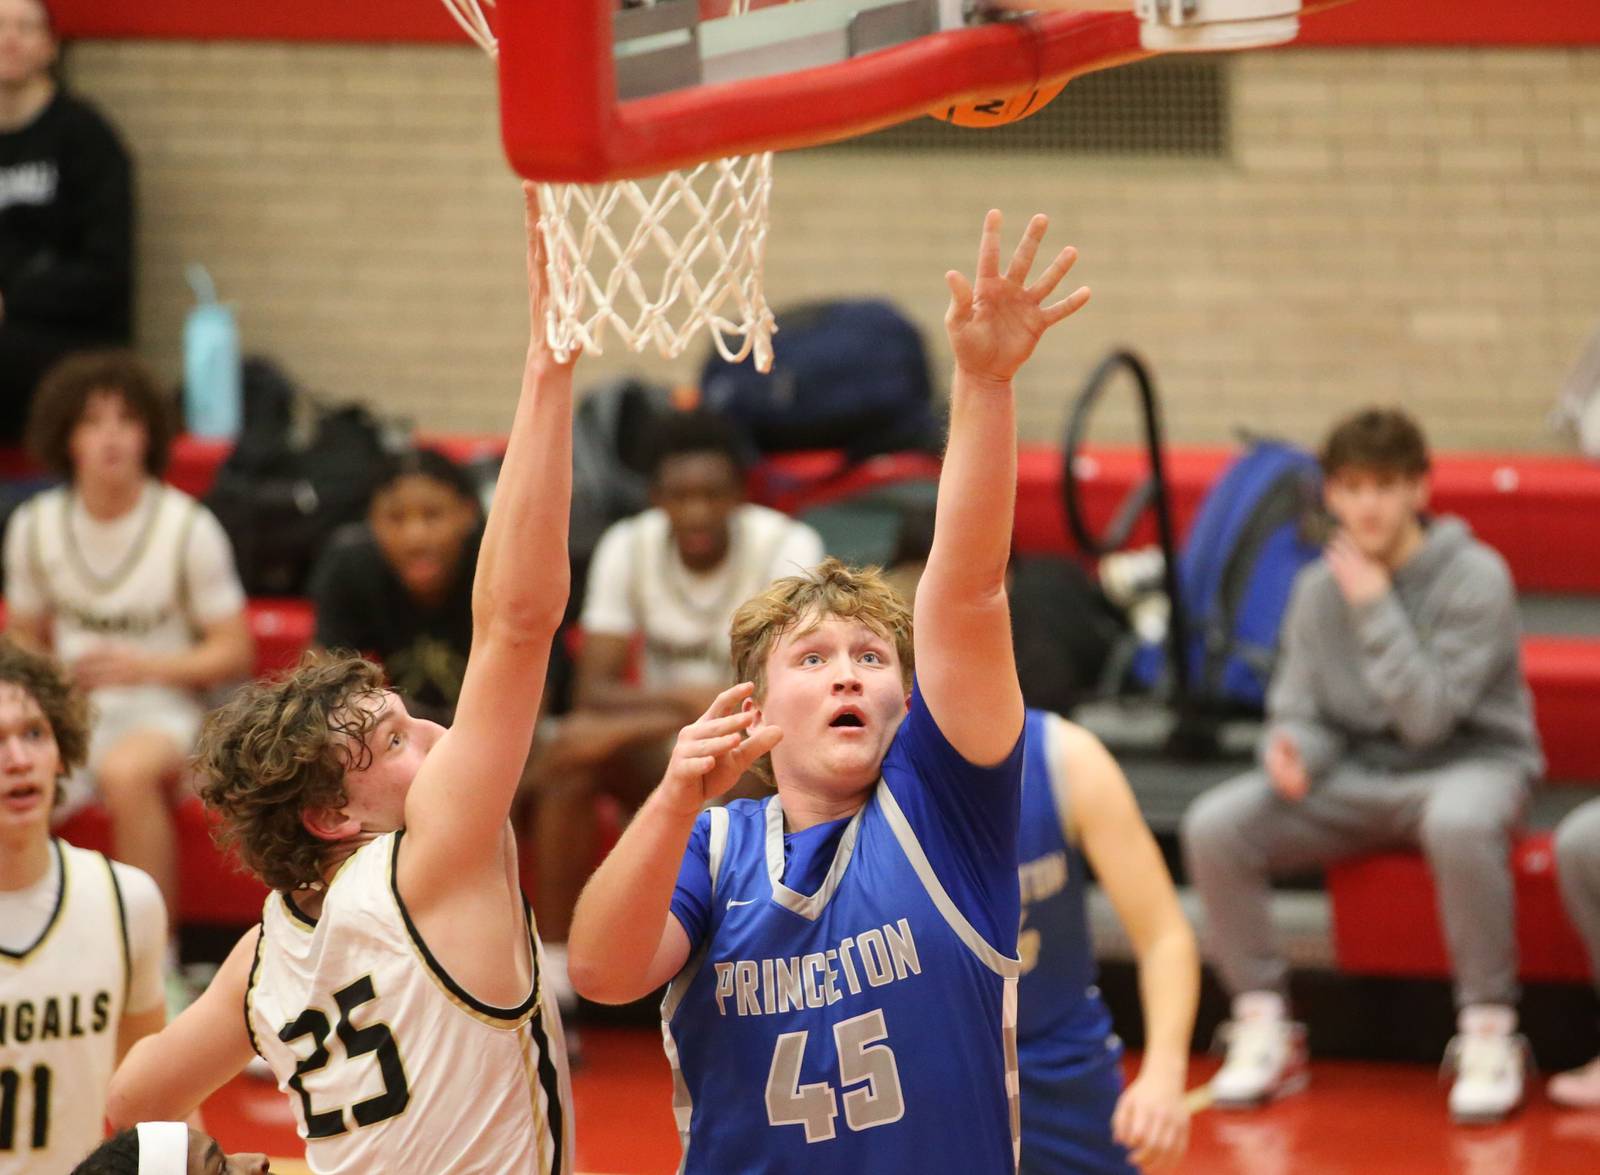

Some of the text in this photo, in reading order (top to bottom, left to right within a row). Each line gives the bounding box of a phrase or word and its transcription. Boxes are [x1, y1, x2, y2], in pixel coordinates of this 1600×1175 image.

[714, 918, 922, 1016] PRINCETON
[277, 974, 410, 1138] 25
[765, 1008, 905, 1144] 45
